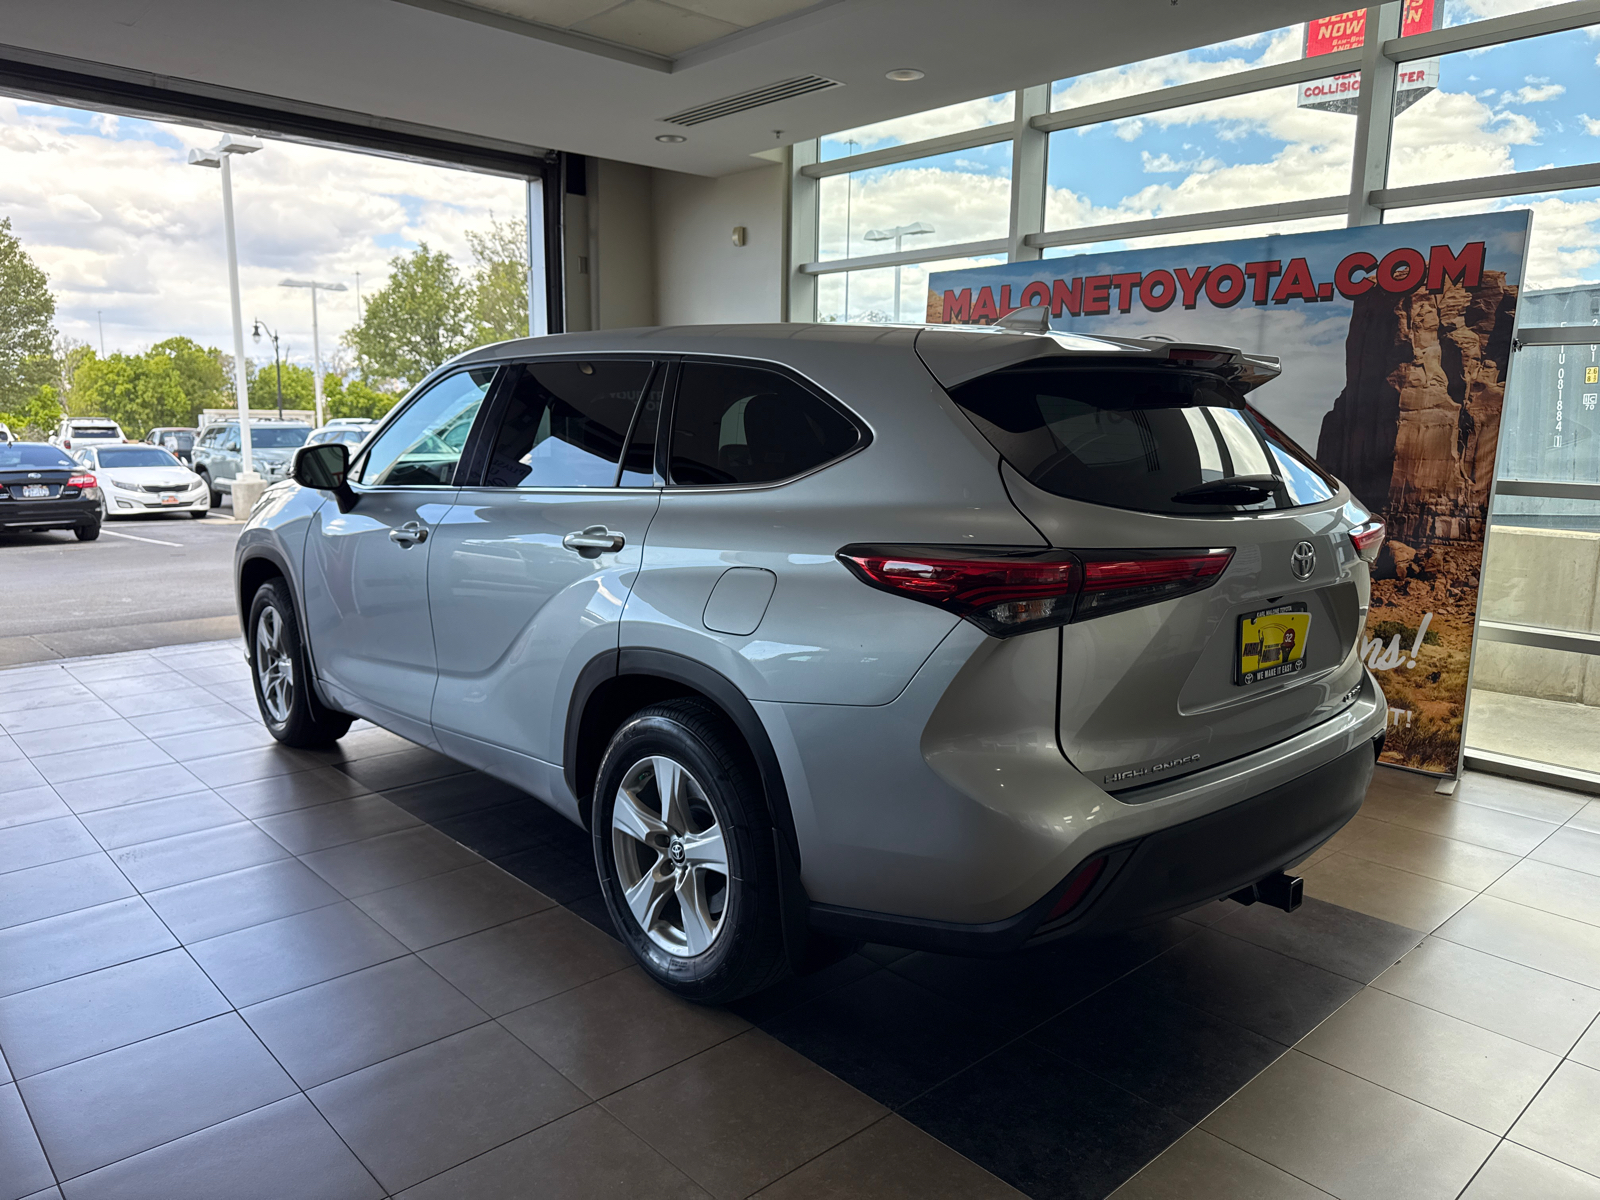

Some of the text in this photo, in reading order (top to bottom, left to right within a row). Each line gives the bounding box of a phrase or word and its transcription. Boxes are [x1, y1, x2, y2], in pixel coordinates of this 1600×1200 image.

[1318, 19, 1364, 40] NOW
[942, 241, 1486, 324] MALONETOYOTA.COM
[1256, 671, 1264, 680] WE
[1264, 667, 1277, 677] MAKE
[1281, 663, 1293, 674] EASY
[1103, 753, 1201, 785] HIGHLANDER
